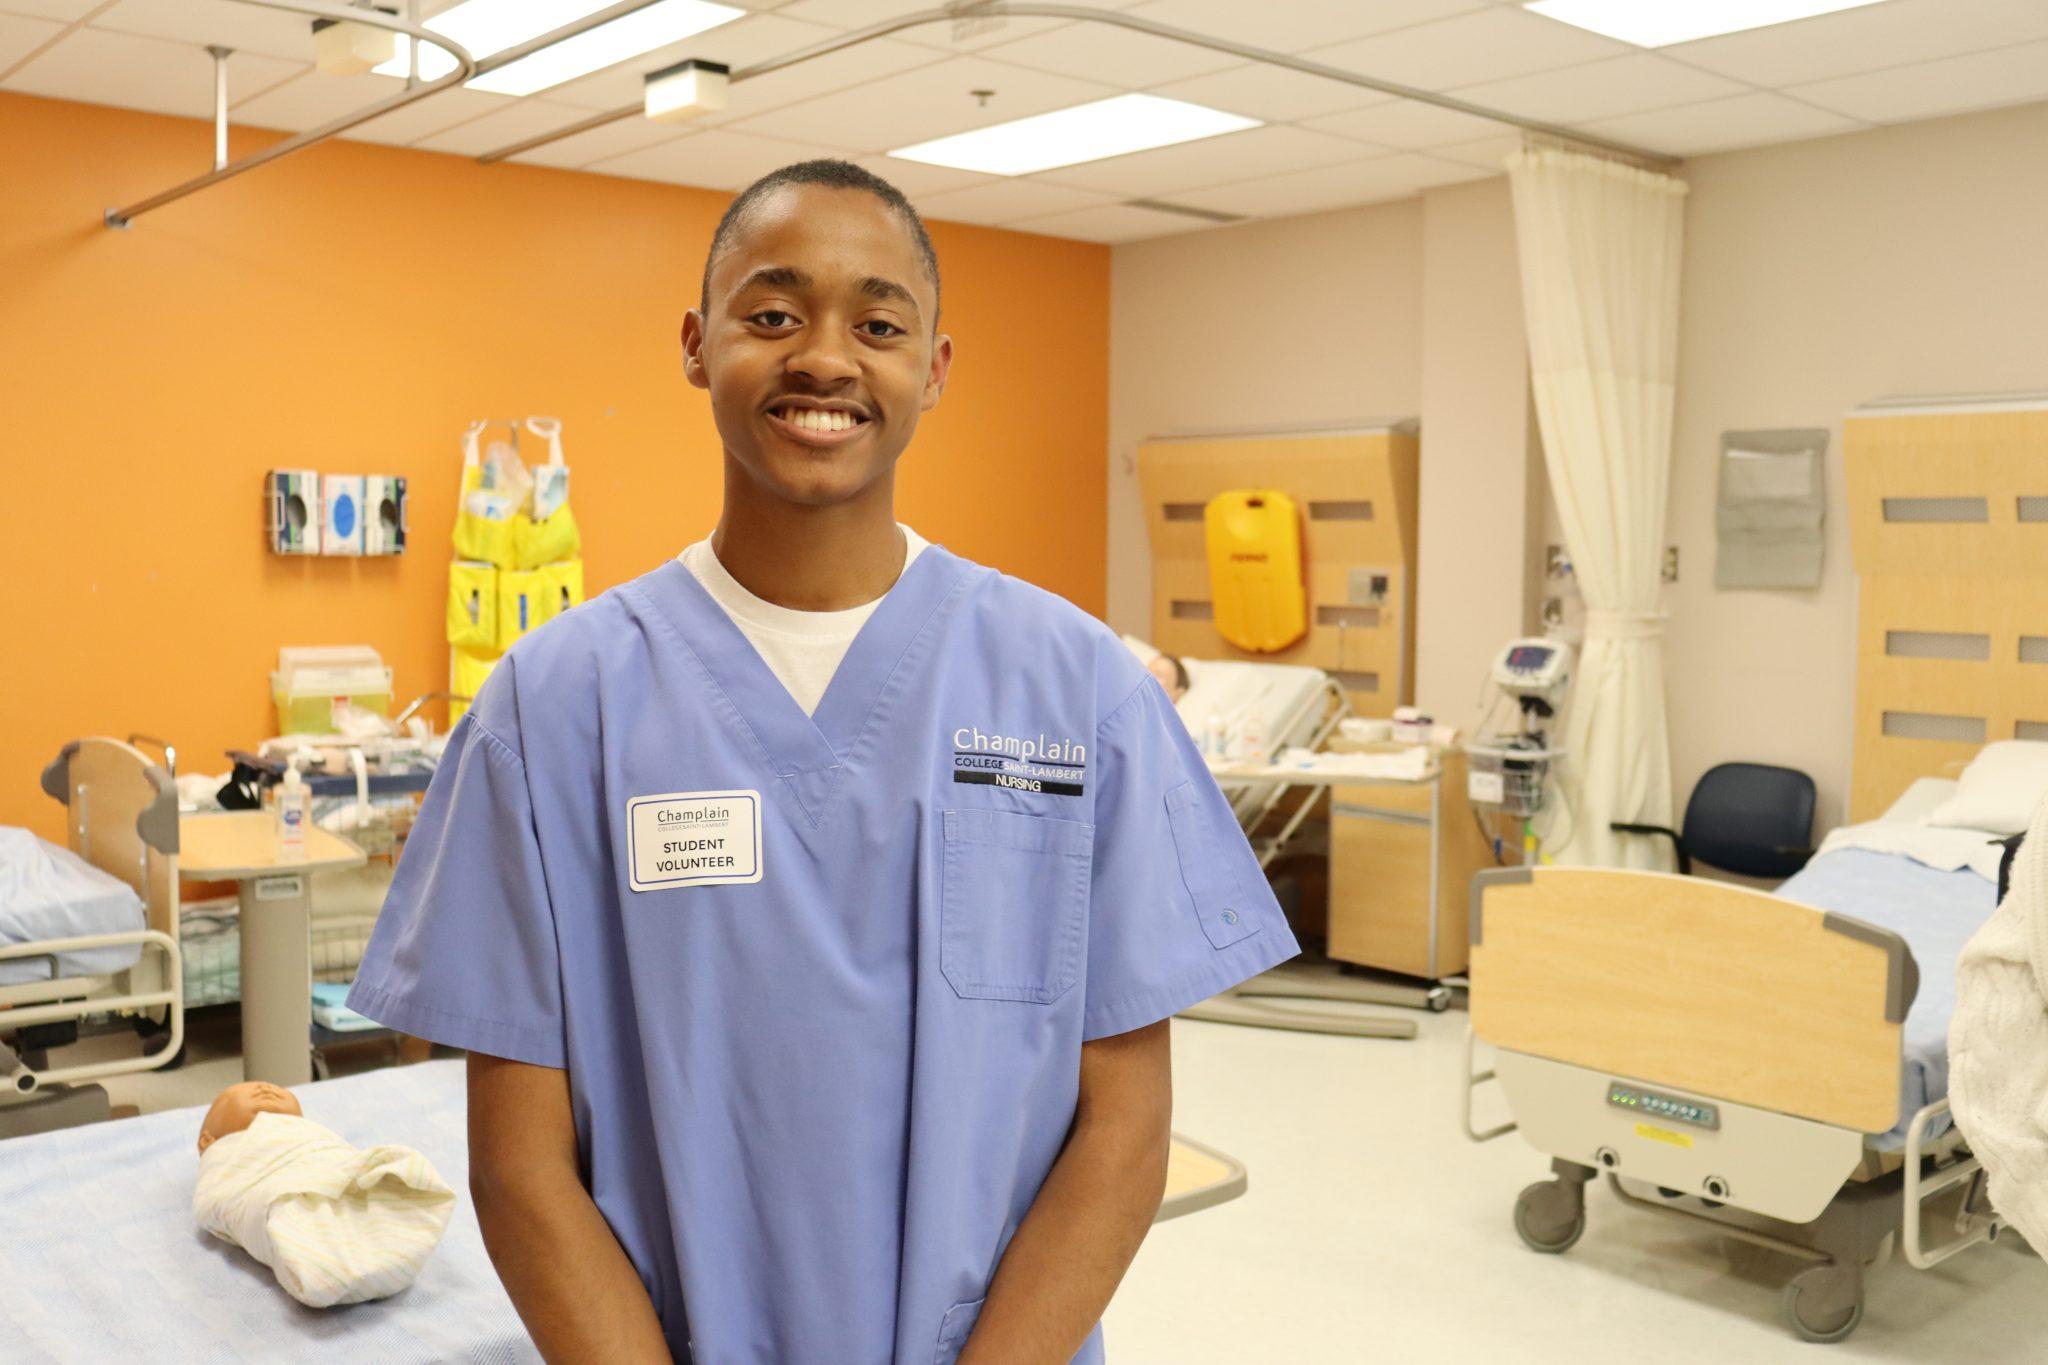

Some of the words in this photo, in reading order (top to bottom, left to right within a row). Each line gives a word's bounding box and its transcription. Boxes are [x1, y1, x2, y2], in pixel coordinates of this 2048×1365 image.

[954, 728, 1085, 762] Champlain
[955, 757, 1004, 769] COLLEGE
[1004, 762, 1085, 780] SAINT-LAMBERT
[995, 774, 1041, 792] NURSING
[658, 807, 729, 822] Champlain
[664, 839, 725, 853] STUDENT
[657, 856, 735, 872] VOLUNTEER
